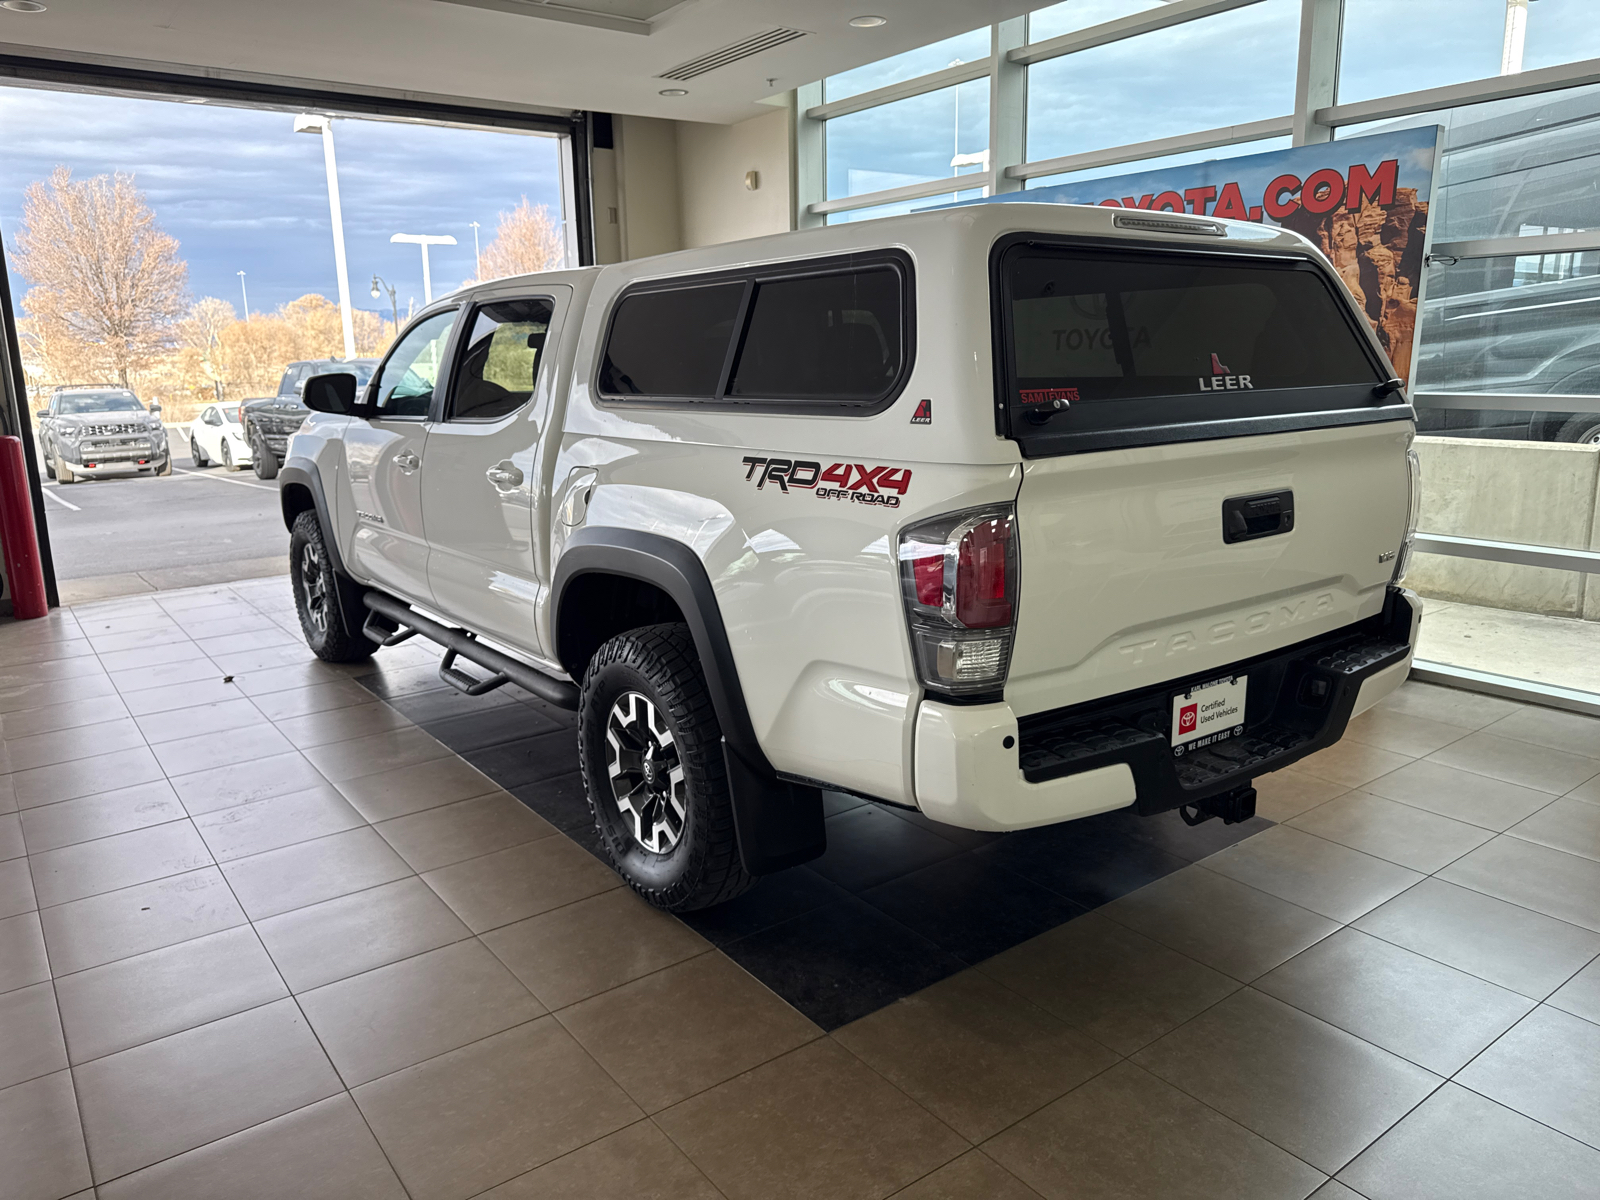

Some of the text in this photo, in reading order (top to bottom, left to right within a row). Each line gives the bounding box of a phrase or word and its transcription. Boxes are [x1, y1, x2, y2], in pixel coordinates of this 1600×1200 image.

[1052, 326, 1152, 350] TOYOA
[1199, 375, 1253, 391] LEER
[816, 488, 900, 508] OFF ROAD
[1119, 593, 1334, 665] TACOMA
[1200, 698, 1226, 713] Certified
[1200, 706, 1239, 724] Used Vehicles
[1188, 730, 1231, 751] WE MAKE IT EASY
